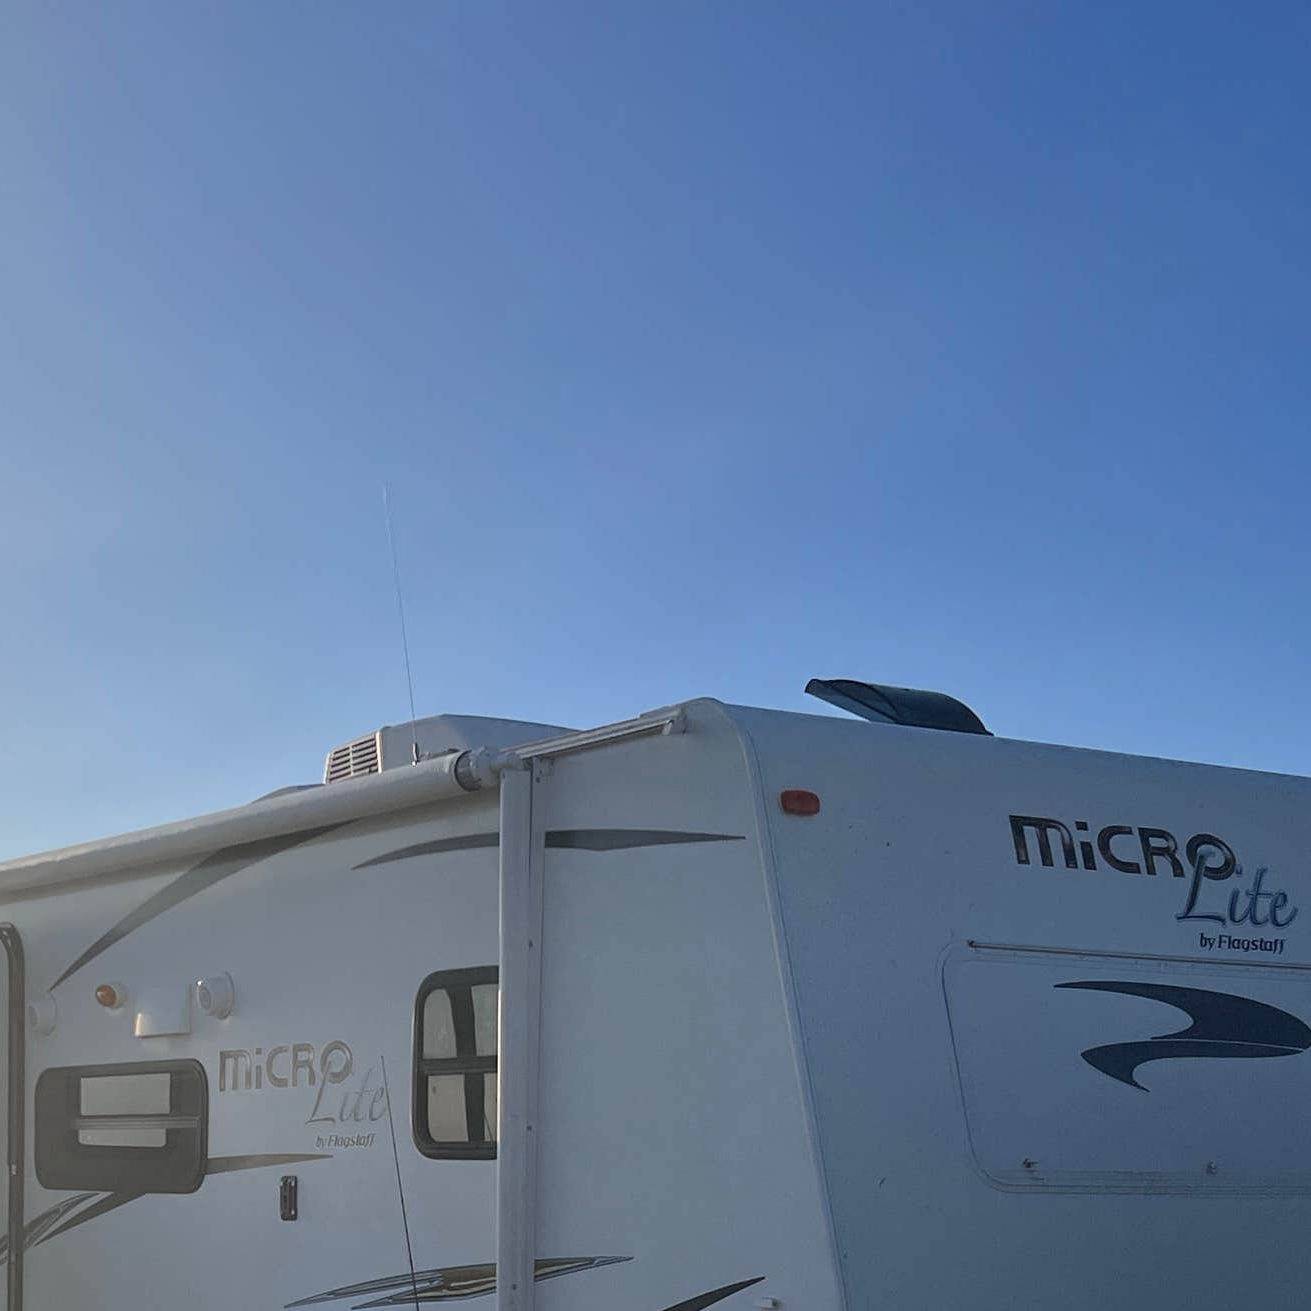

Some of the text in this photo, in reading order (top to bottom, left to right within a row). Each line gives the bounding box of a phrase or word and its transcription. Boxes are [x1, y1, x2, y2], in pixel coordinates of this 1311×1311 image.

[1175, 852, 1299, 928] Lite
[1200, 932, 1287, 955] by Flagstaff
[304, 1059, 387, 1125] Lite
[315, 1133, 376, 1149] by Flagstaff
